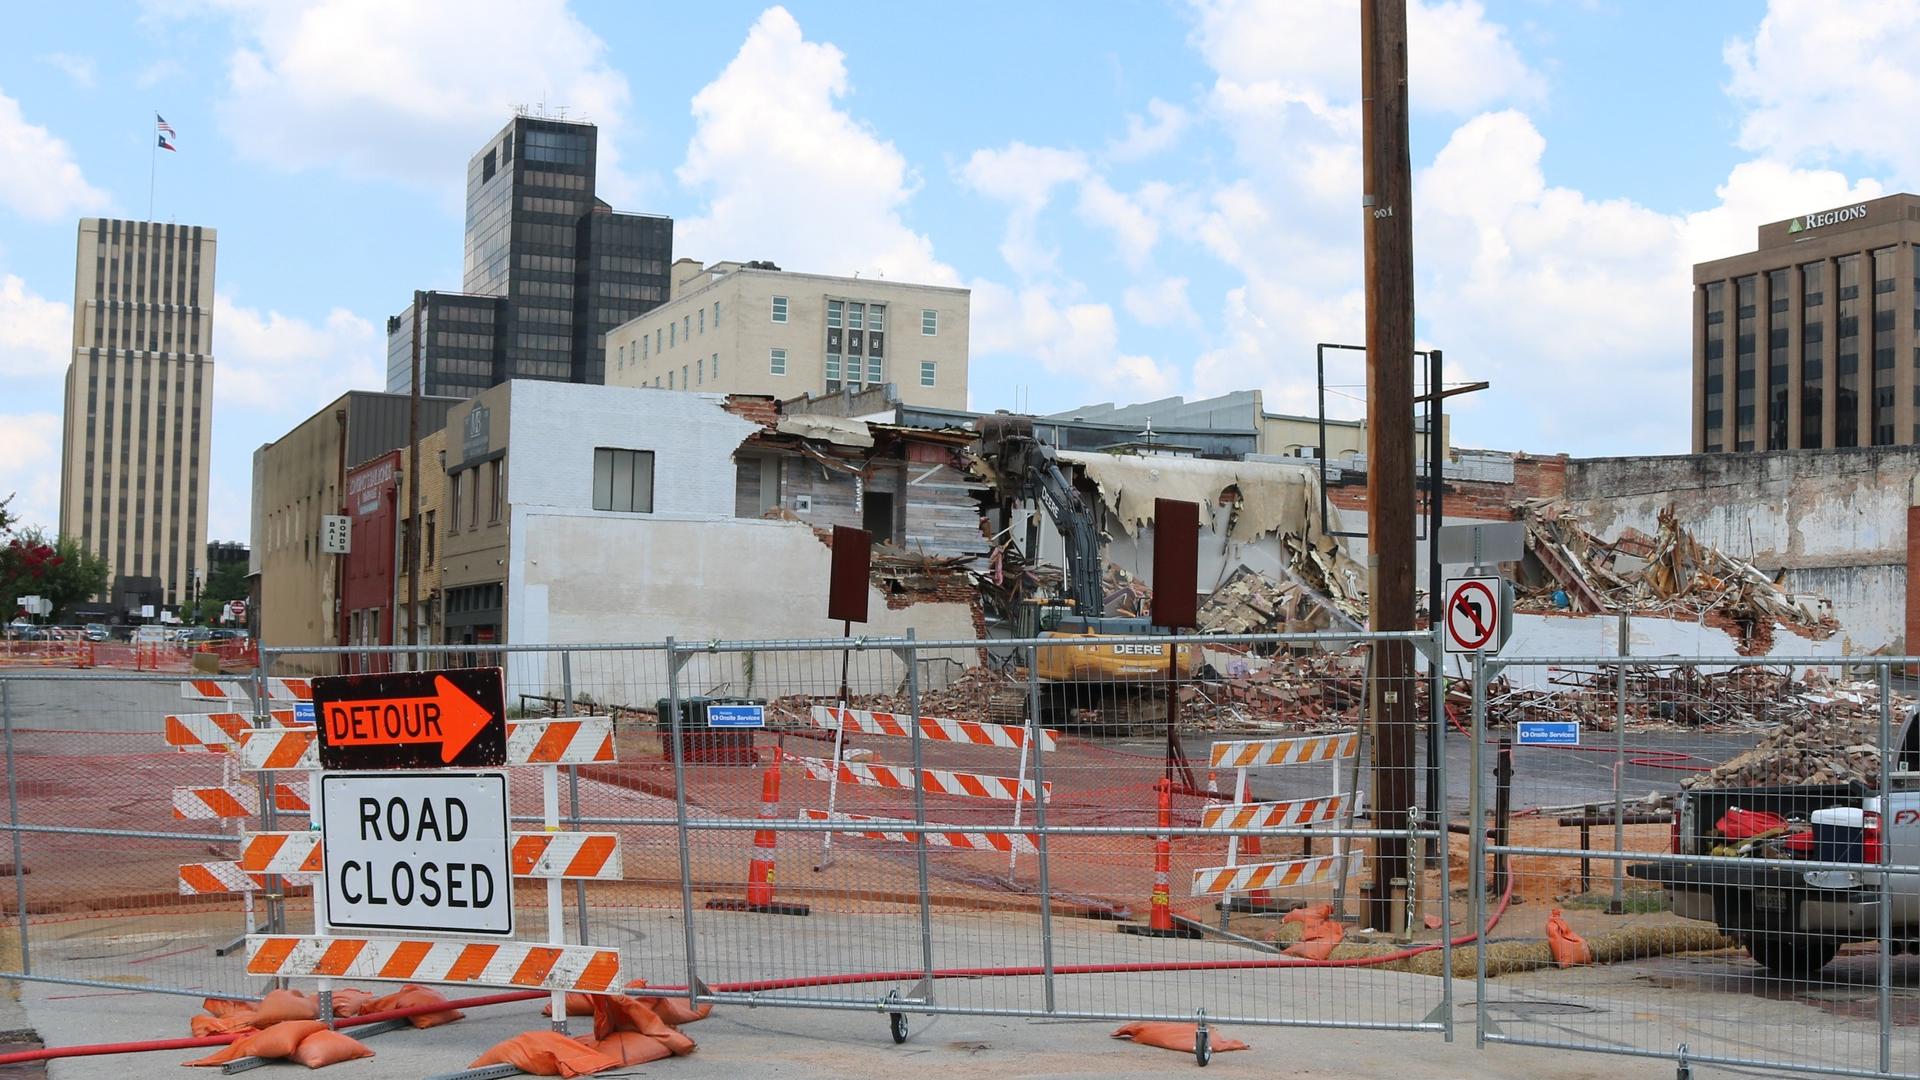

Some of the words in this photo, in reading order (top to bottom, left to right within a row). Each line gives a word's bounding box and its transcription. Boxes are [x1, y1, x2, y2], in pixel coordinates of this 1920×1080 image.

[1805, 205, 1866, 229] REGIONS
[1042, 485, 1060, 519] DEERE
[1114, 644, 1162, 655] DEERE
[331, 703, 443, 740] DETOUR
[359, 796, 468, 842] ROAD
[340, 859, 494, 909] CLOSED
